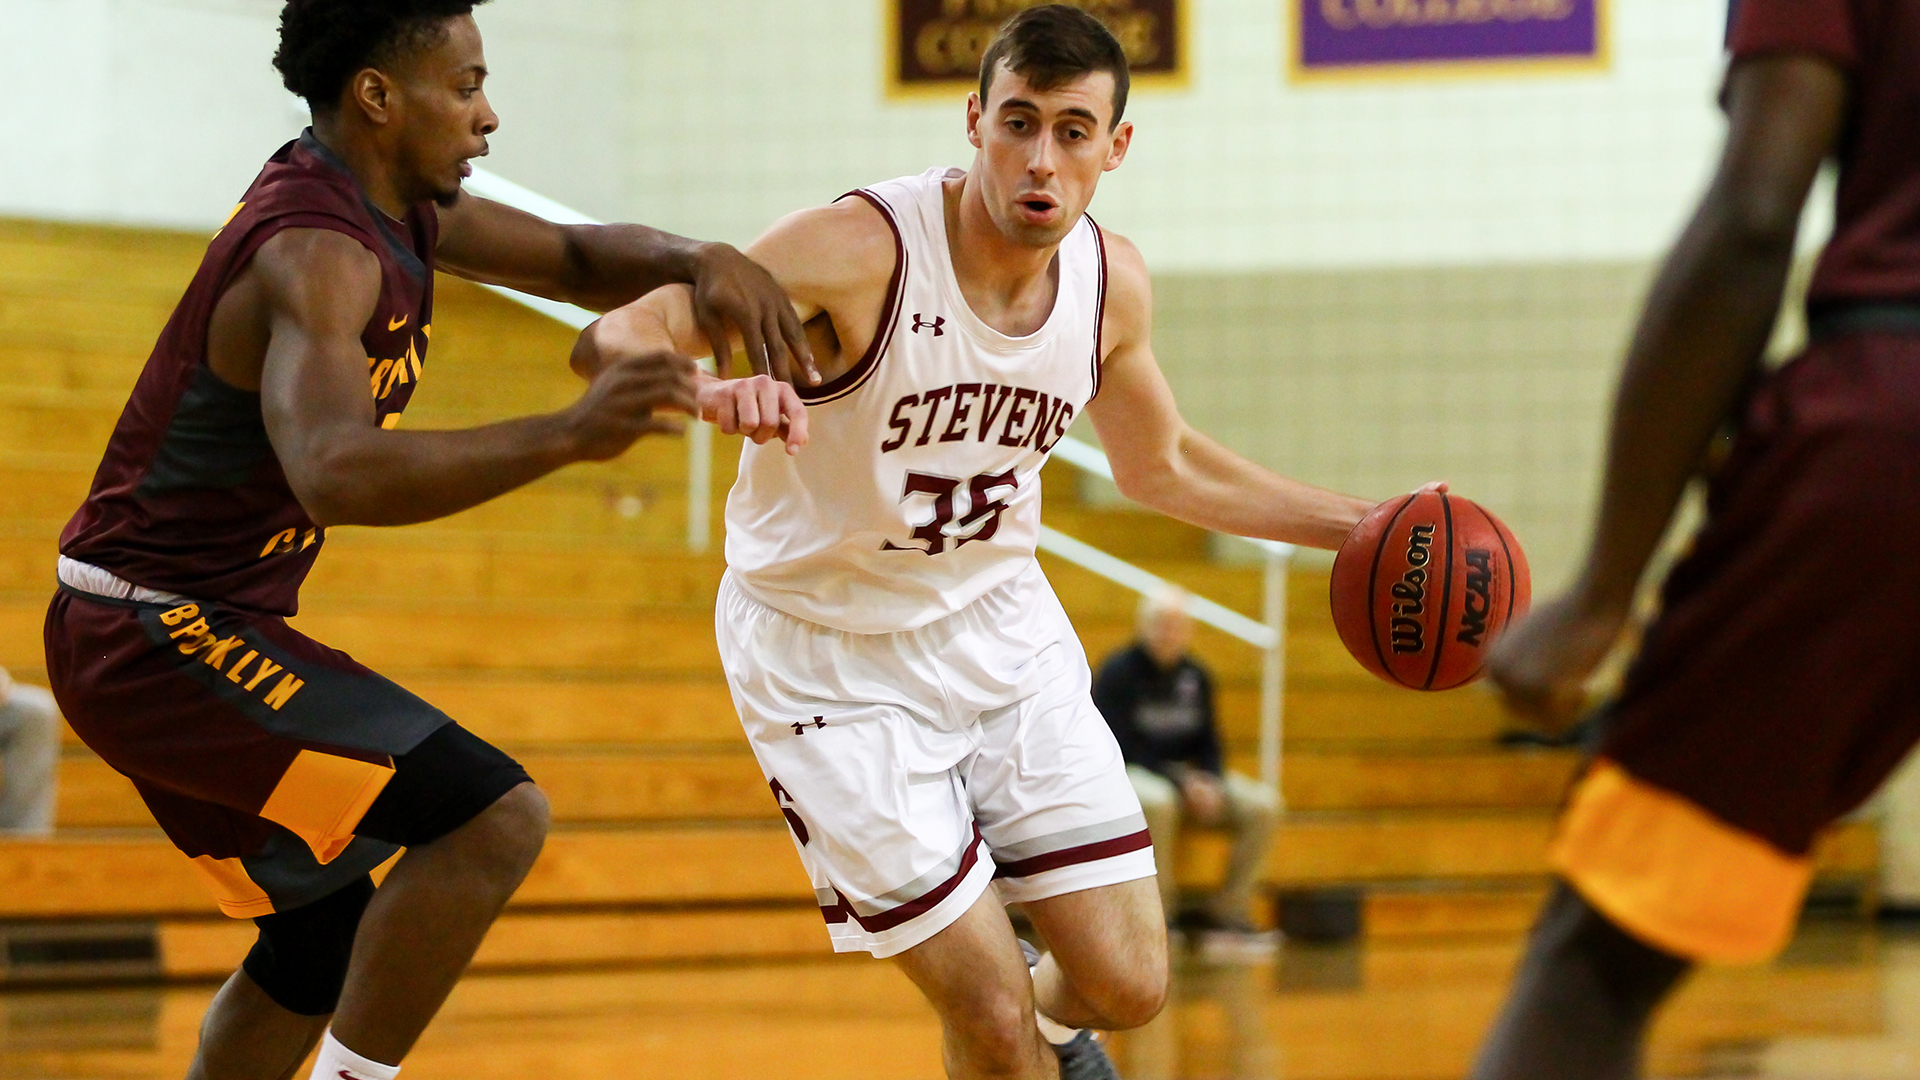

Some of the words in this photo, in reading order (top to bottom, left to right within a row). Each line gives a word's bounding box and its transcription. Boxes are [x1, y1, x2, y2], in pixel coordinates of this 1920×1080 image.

[881, 382, 1074, 454] STEVENS
[879, 467, 1020, 556] 35
[1390, 521, 1436, 655] Wilson
[1456, 548, 1492, 648] NCAA
